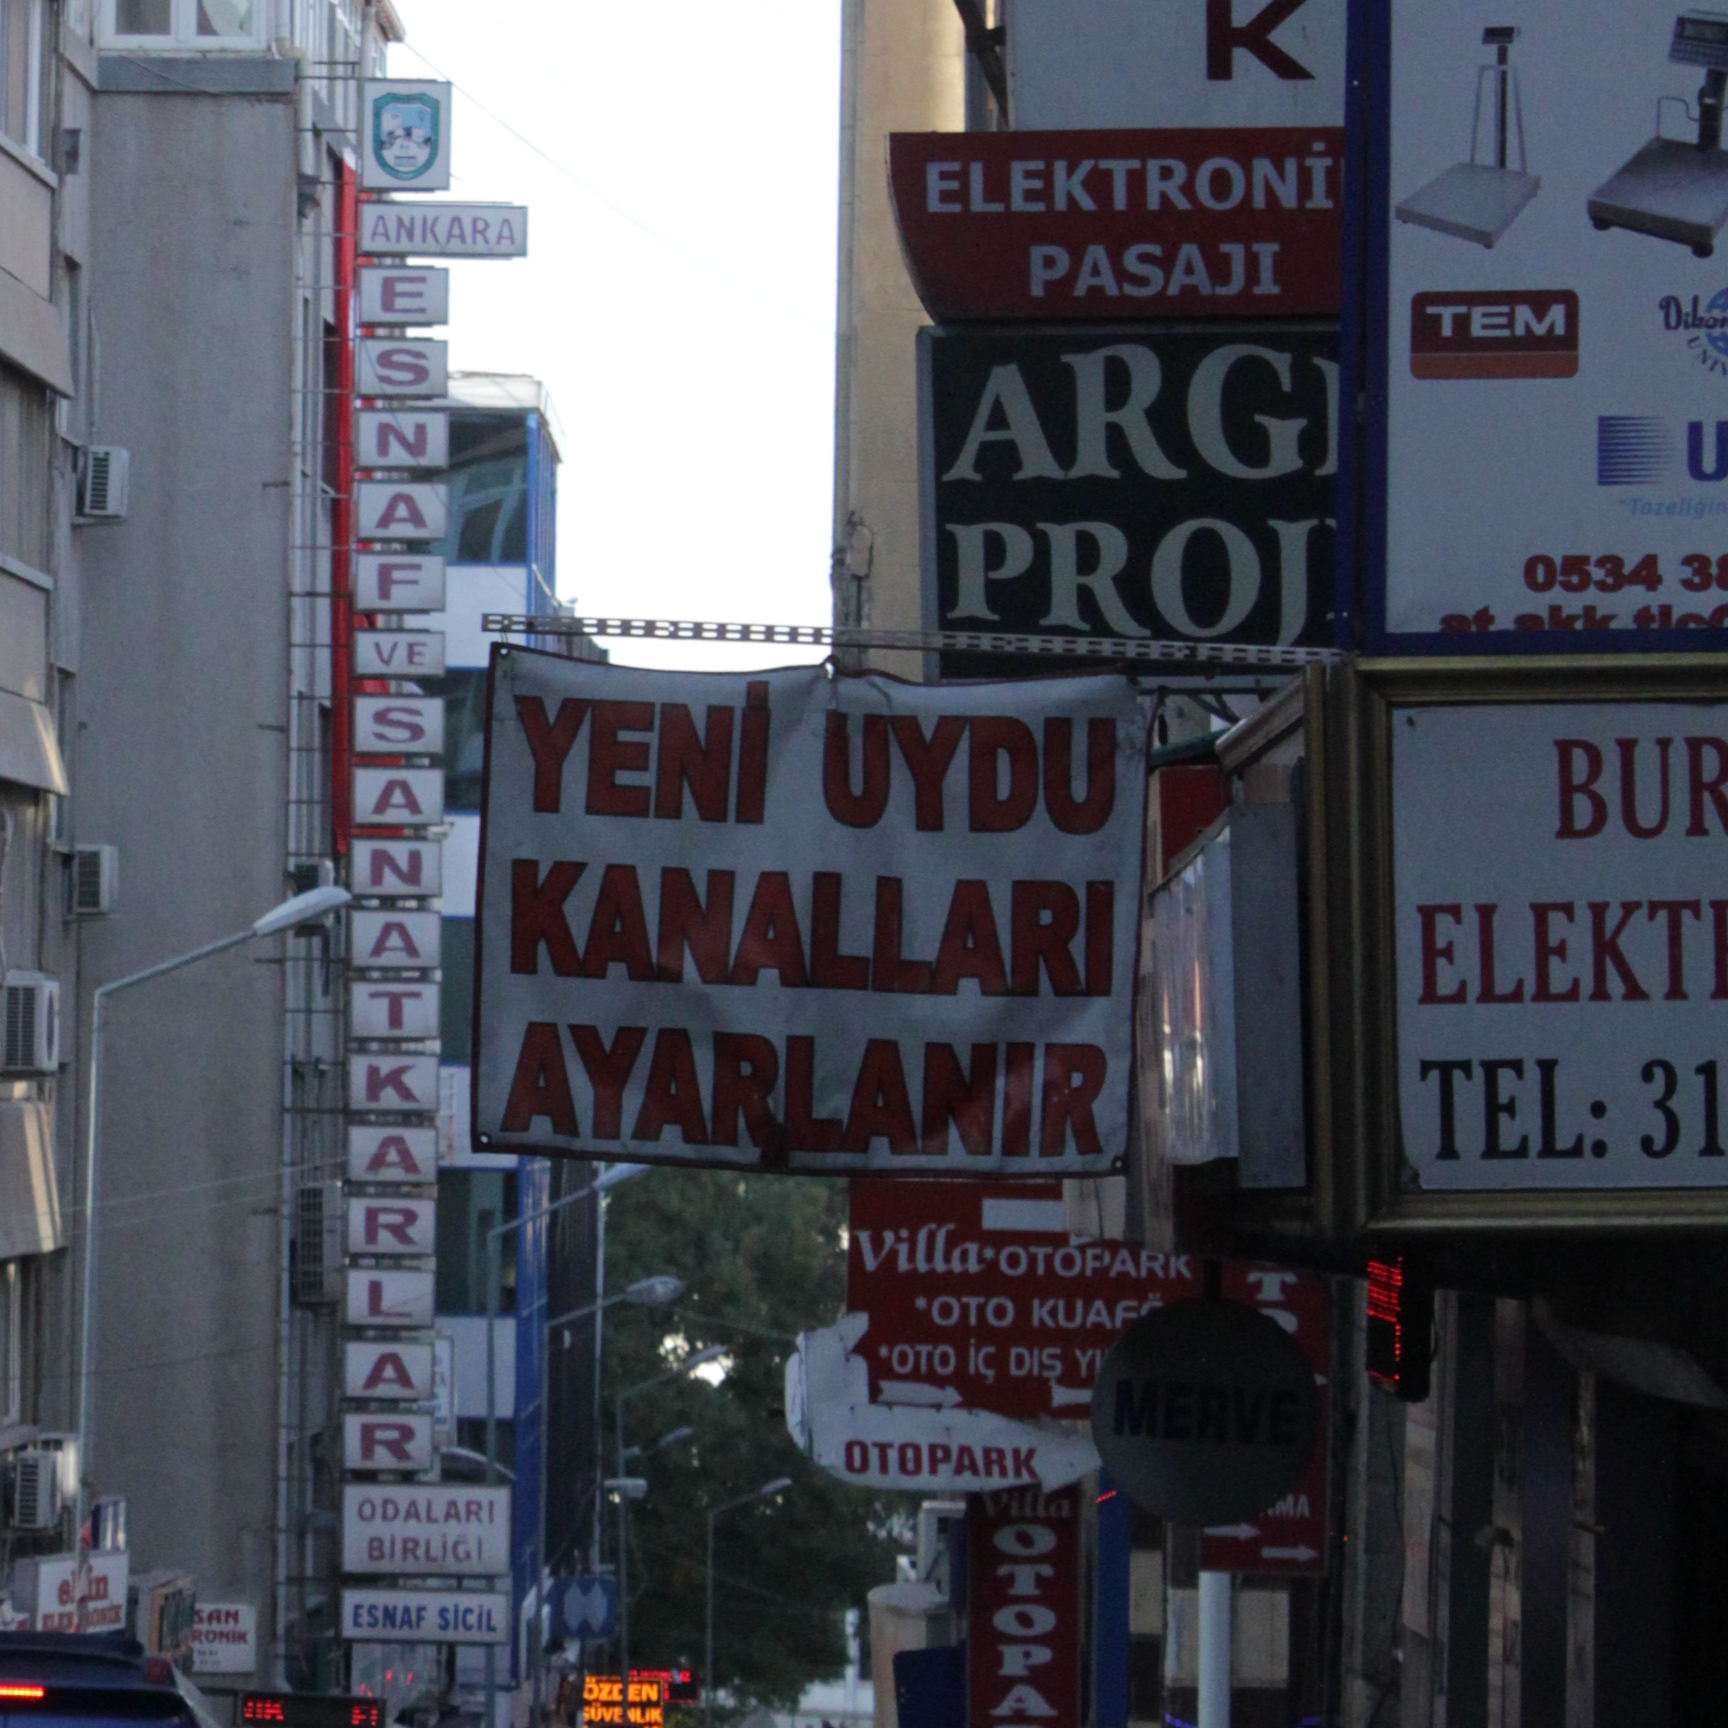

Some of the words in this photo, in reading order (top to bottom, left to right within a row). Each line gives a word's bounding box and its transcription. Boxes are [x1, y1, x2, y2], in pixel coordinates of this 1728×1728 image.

[925, 140, 1344, 214] ELEKTRONİ
[371, 214, 517, 246] ANKARA
[1029, 240, 1282, 298] PASAJI
[1425, 302, 1567, 338] TEM
[375, 275, 429, 601] ESNAF
[1523, 552, 1664, 594] 0534
[374, 641, 428, 666] VE
[514, 680, 771, 824] YENİ
[822, 708, 1118, 834] UYDU
[509, 858, 1116, 998] KANALLARI
[360, 705, 426, 1461] SANATKARLAR
[499, 1022, 1106, 1166] AYARLANIR
[1420, 1058, 1608, 1160] TEL:
[853, 1222, 986, 1274] Villa
[1113, 1377, 1299, 1446] MERVE
[844, 1440, 1040, 1480] OTOPARK
[357, 1498, 495, 1525] ODALARI
[352, 1603, 427, 1631] ESNAF
[437, 1602, 497, 1633] SİCİL
